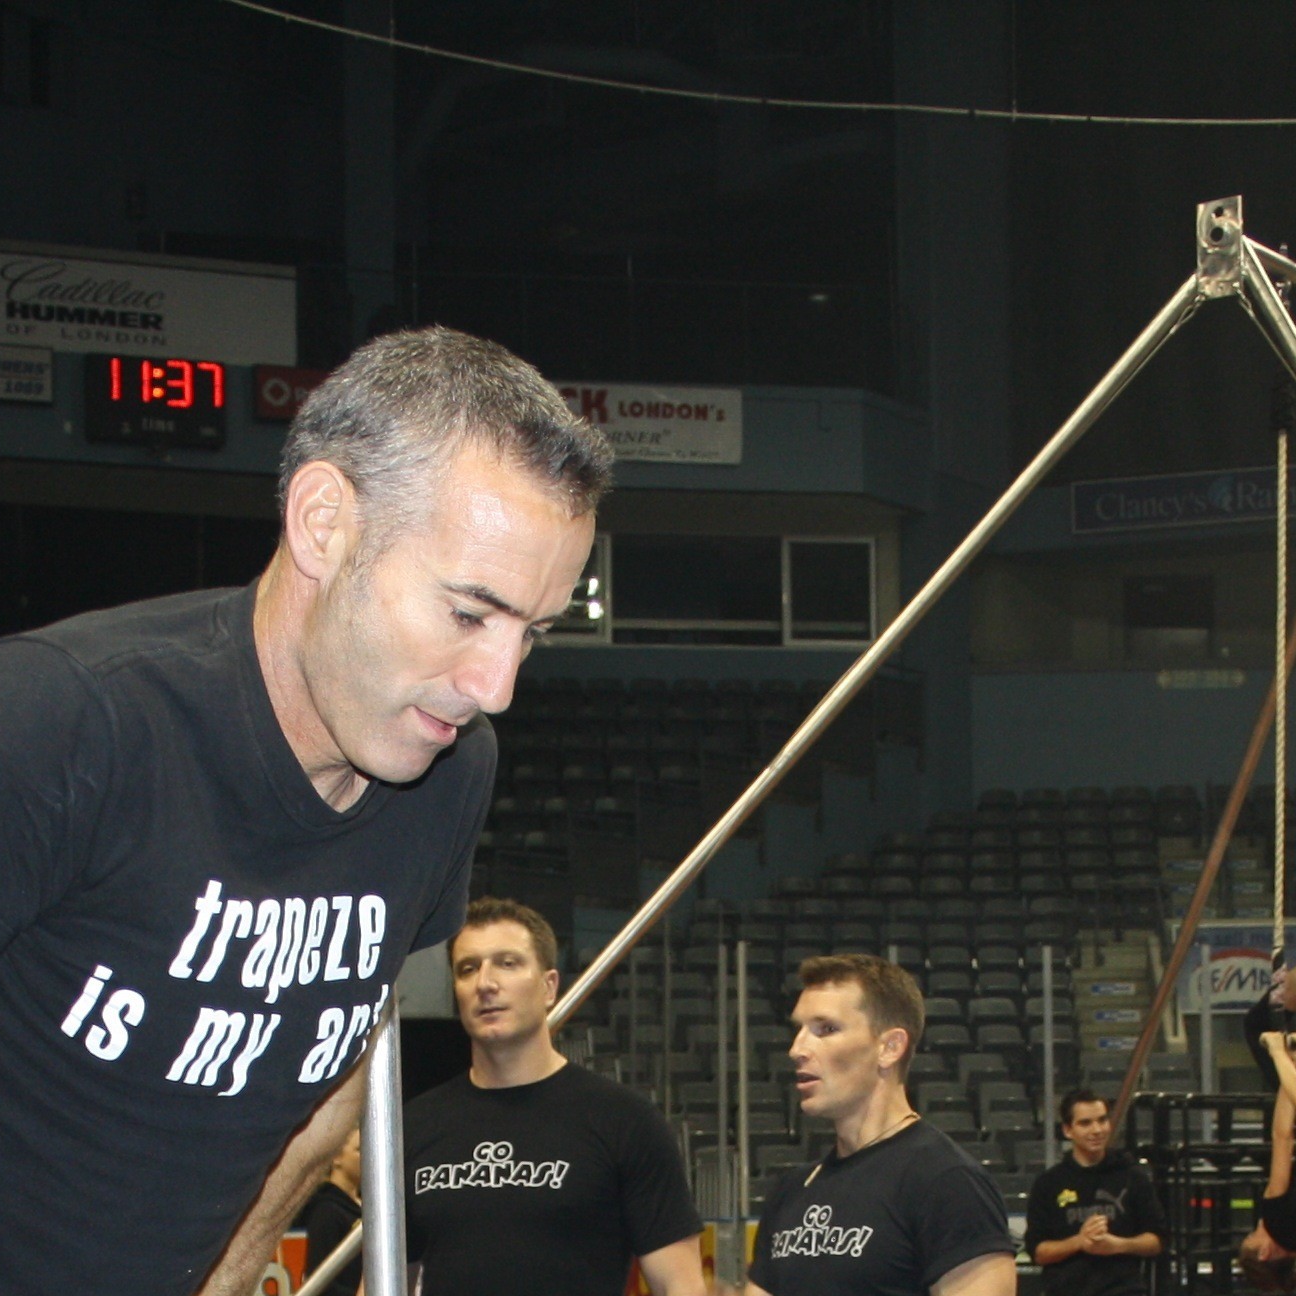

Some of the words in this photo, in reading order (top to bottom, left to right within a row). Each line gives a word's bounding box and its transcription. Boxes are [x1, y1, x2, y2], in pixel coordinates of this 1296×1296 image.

[0, 261, 165, 310] Cadillac
[5, 300, 164, 331] HUMMER
[6, 324, 33, 337] OF
[60, 328, 168, 347] LONDON
[109, 356, 225, 408] 11:37
[1095, 491, 1209, 524] Clancy's
[168, 879, 387, 1005] trapeze
[60, 964, 146, 1062] is
[165, 1006, 281, 1097] my
[473, 1141, 513, 1163] GO
[415, 1160, 570, 1195] BANANAS!
[803, 1204, 833, 1228] GO
